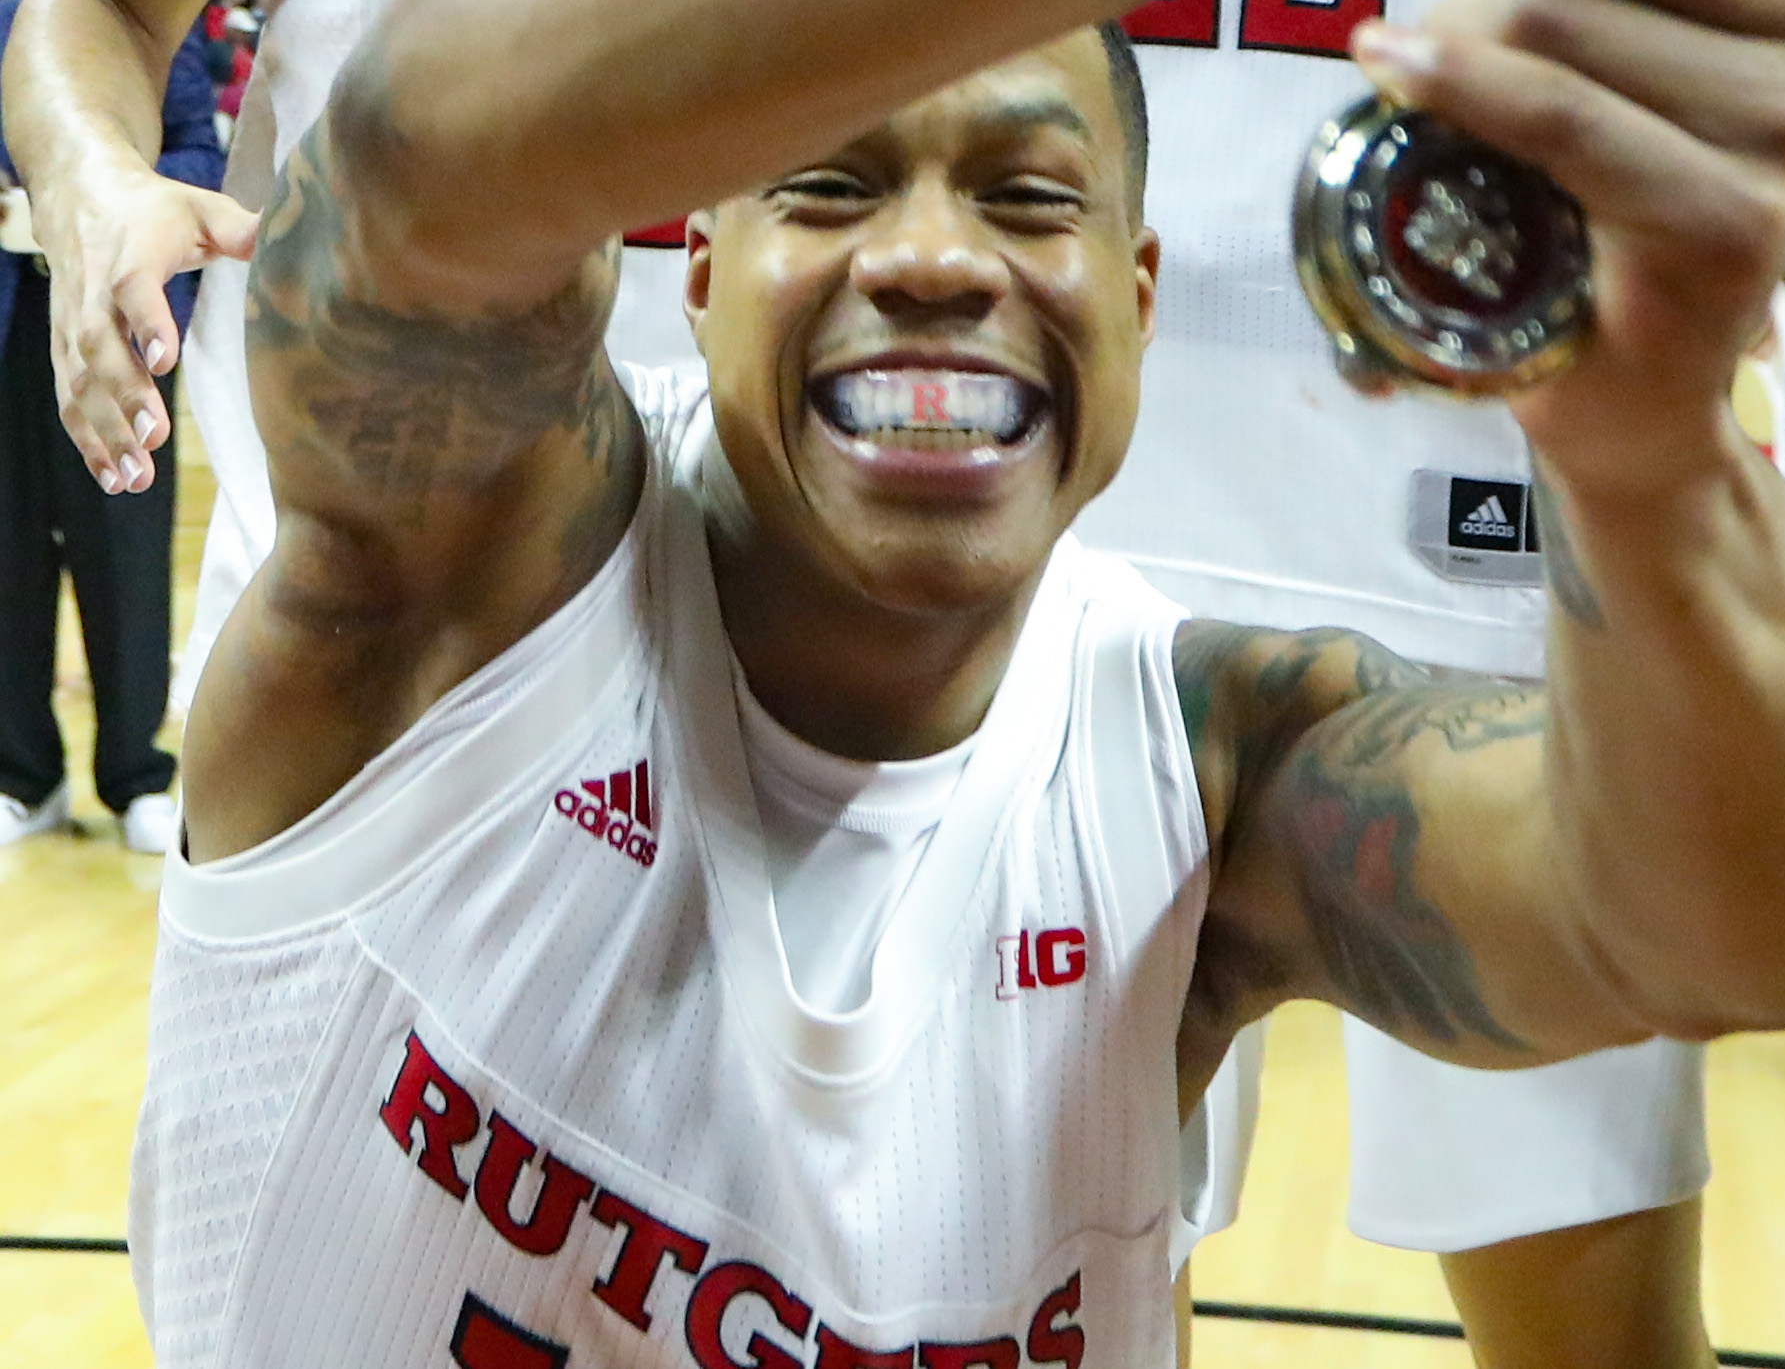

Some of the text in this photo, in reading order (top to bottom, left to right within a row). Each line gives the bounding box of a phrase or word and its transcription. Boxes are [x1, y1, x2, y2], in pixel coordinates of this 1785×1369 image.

[911, 382, 950, 423] R
[1460, 520, 1515, 538] adidas
[554, 789, 658, 867] adidas
